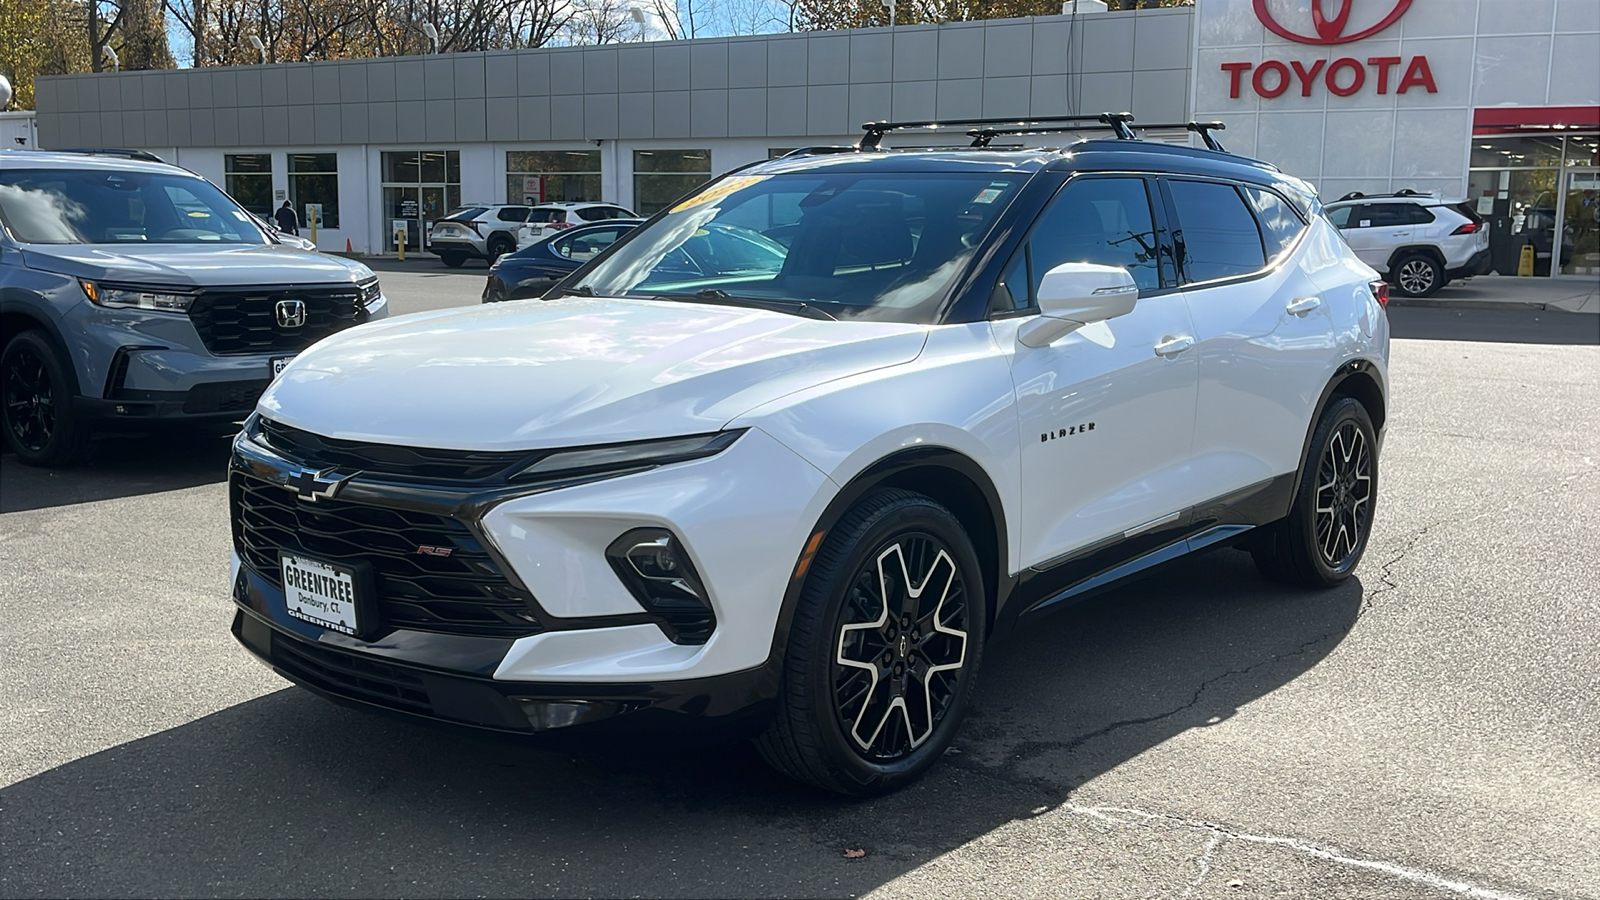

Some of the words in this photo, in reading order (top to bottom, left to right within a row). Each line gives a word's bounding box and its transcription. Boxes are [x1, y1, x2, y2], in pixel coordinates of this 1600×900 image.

[1221, 55, 1438, 99] TOYOTA
[1041, 422, 1096, 443] BLAZER
[417, 545, 452, 557] RS
[285, 565, 353, 604] GREENTREE
[298, 592, 329, 613] Danbury,
[330, 602, 341, 614] CT.
[287, 609, 354, 635] GREENTREE
